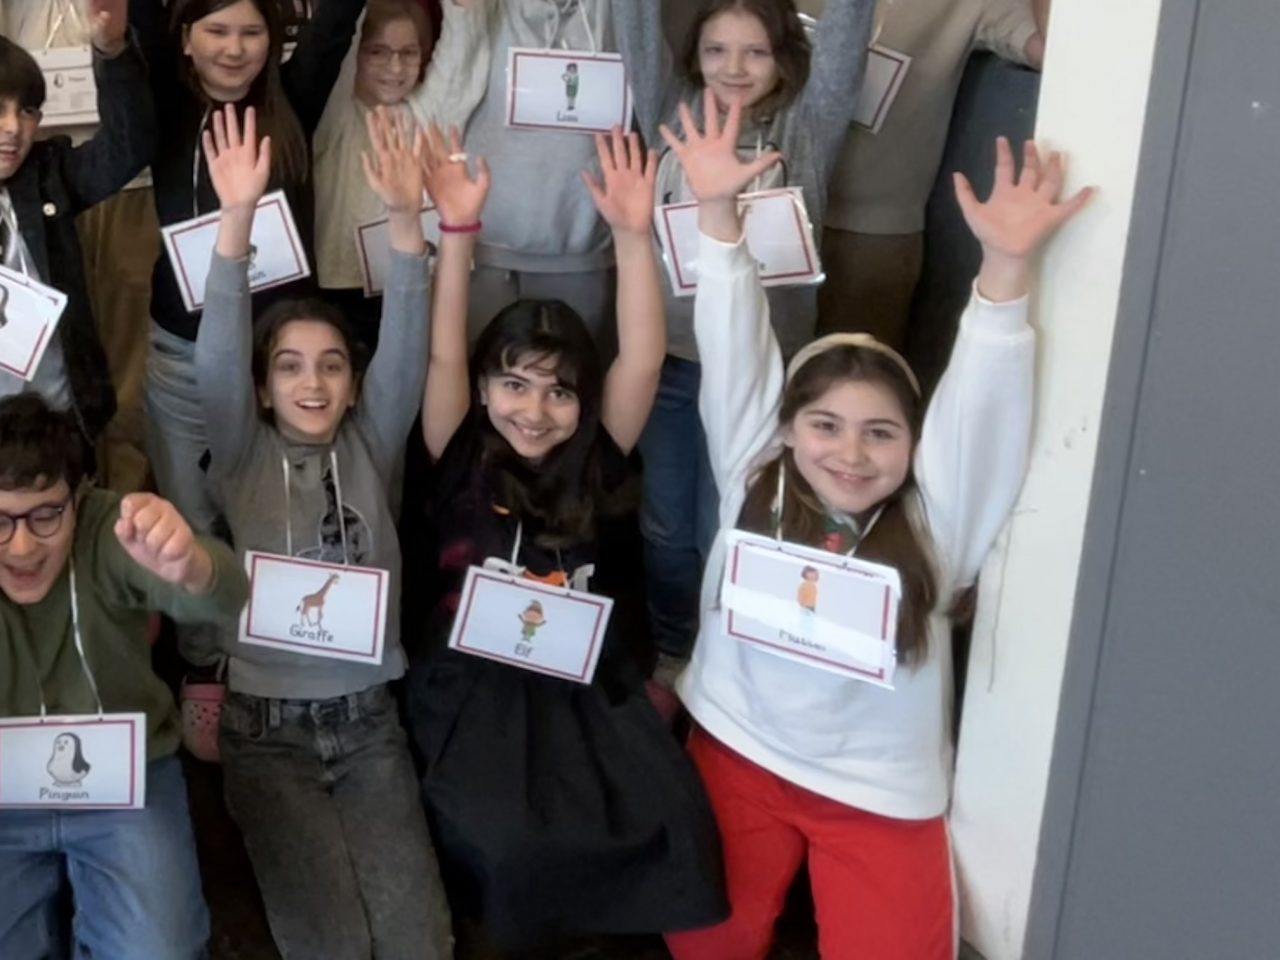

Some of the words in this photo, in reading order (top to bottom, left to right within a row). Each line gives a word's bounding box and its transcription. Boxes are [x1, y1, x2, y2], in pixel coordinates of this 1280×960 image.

[288, 623, 335, 643] Giraffe
[513, 643, 534, 659] Elf
[38, 787, 90, 801] Pinguin
